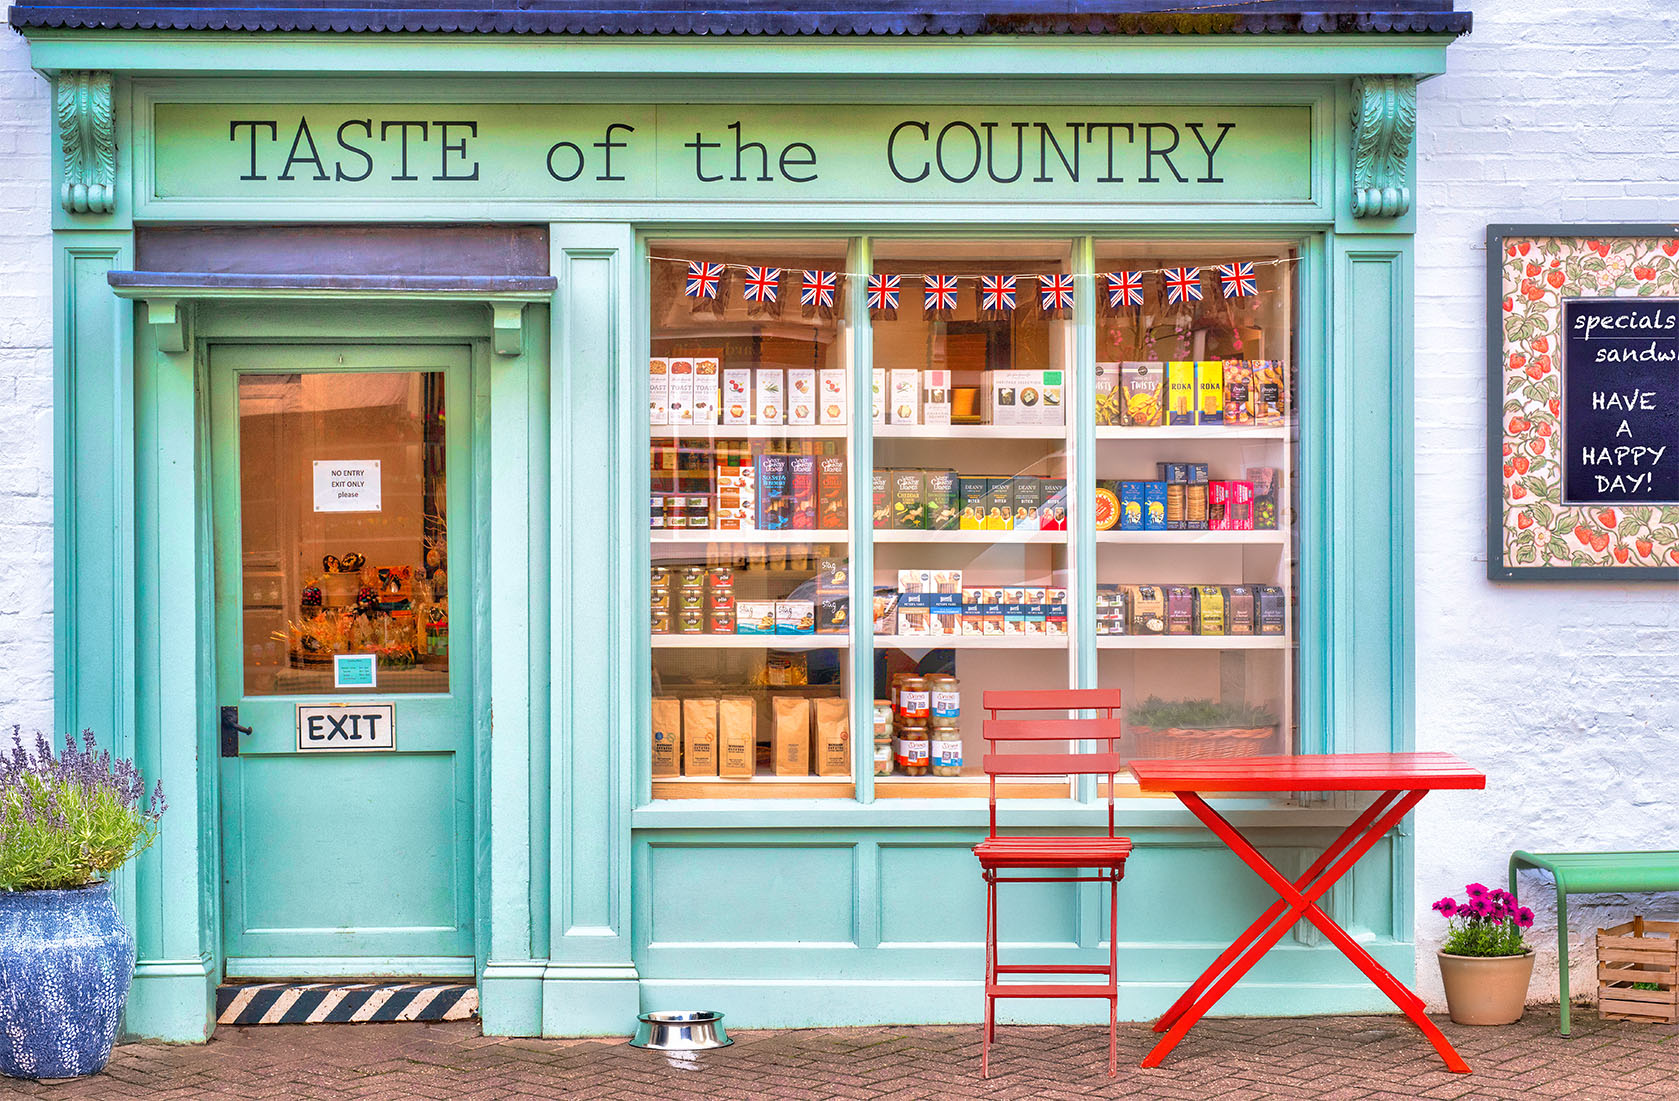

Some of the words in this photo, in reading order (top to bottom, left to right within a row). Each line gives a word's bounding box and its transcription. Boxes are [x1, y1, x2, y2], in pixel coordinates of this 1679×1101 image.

[230, 115, 480, 182] TASTE
[546, 122, 635, 182] of
[684, 120, 819, 183] the
[887, 120, 1236, 184] COUNTRY
[1573, 309, 1677, 341] specials
[1595, 341, 1679, 362] sandw
[1171, 383, 1192, 391] ROKA
[1200, 383, 1221, 391] ROKA
[1592, 388, 1657, 412] HAVE
[1616, 419, 1633, 438] A
[1582, 445, 1667, 466] HAPPY
[331, 469, 342, 477] NO
[343, 469, 365, 477] ENTRY
[1594, 471, 1653, 493] DAY!
[331, 480, 346, 488] EXIT
[346, 480, 365, 488] ONLY
[337, 491, 359, 499] please
[307, 714, 383, 741] EXIT
